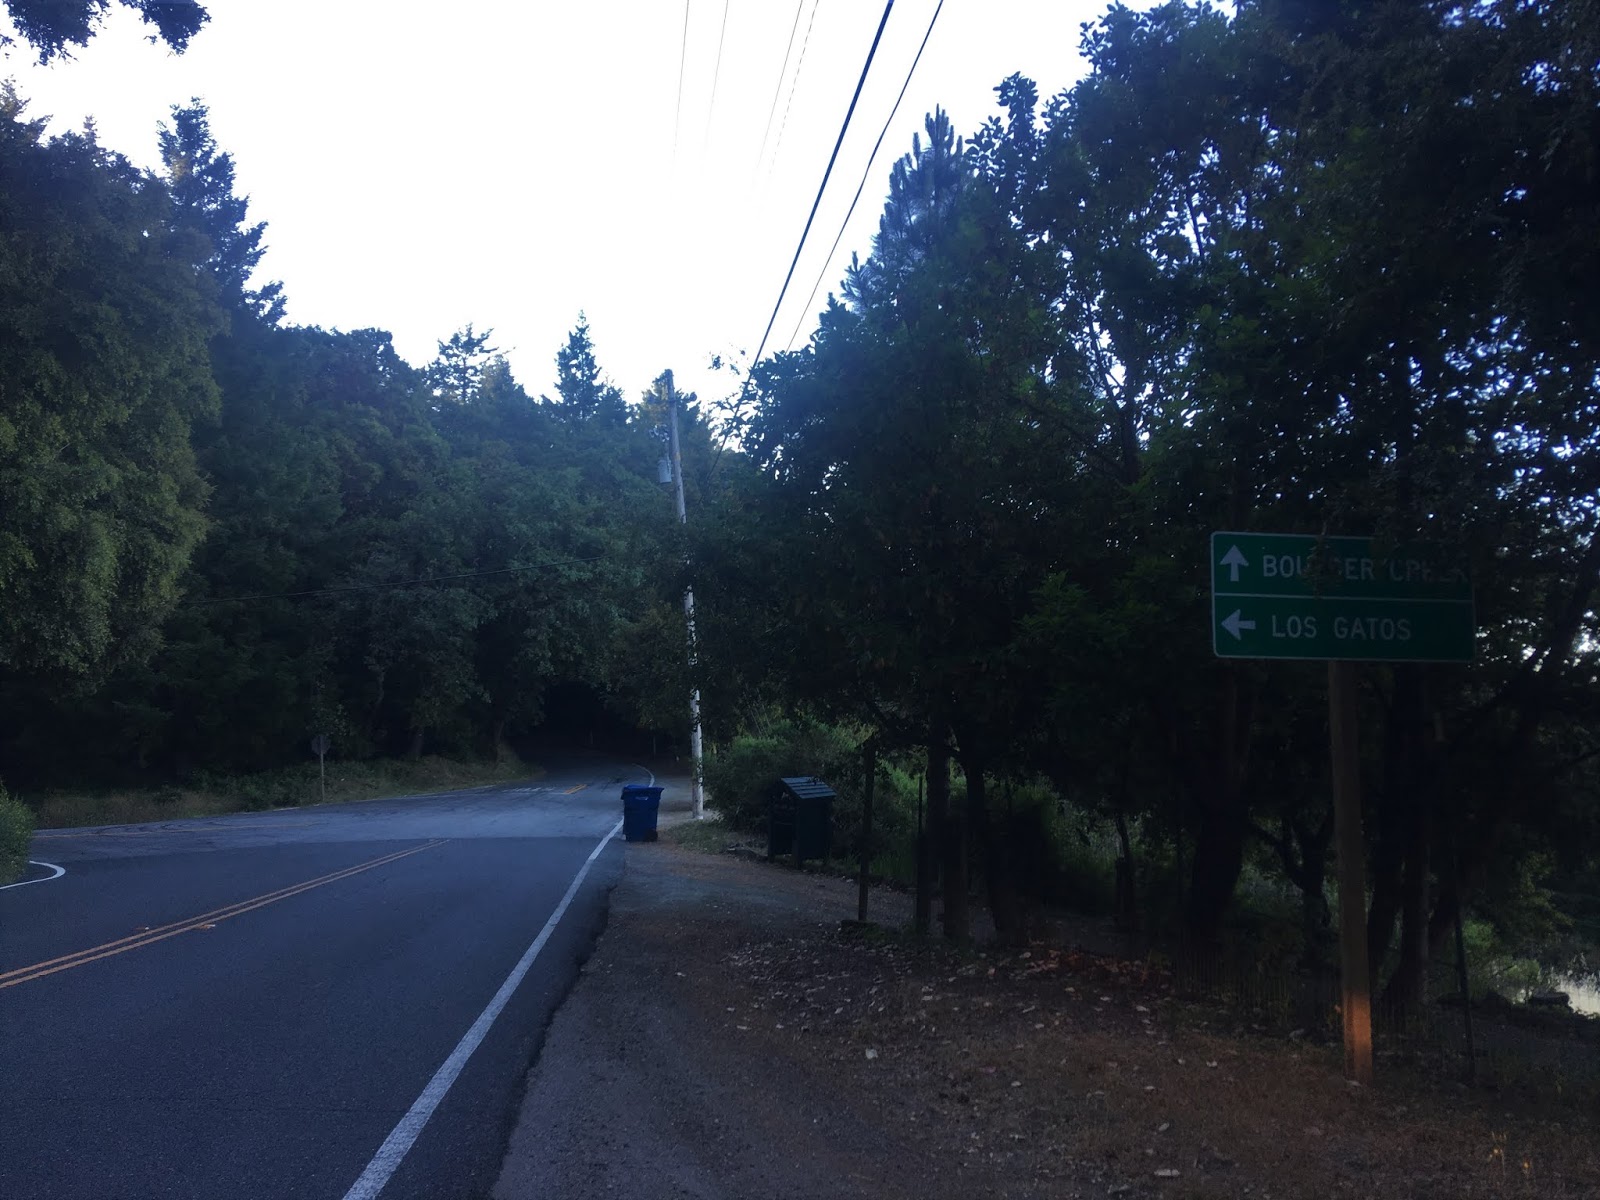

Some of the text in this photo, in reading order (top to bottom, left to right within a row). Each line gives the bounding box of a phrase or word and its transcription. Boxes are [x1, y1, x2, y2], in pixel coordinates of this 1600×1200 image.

[1262, 554, 1376, 581] BOUER
[1271, 614, 1412, 641] LOS GATOS
